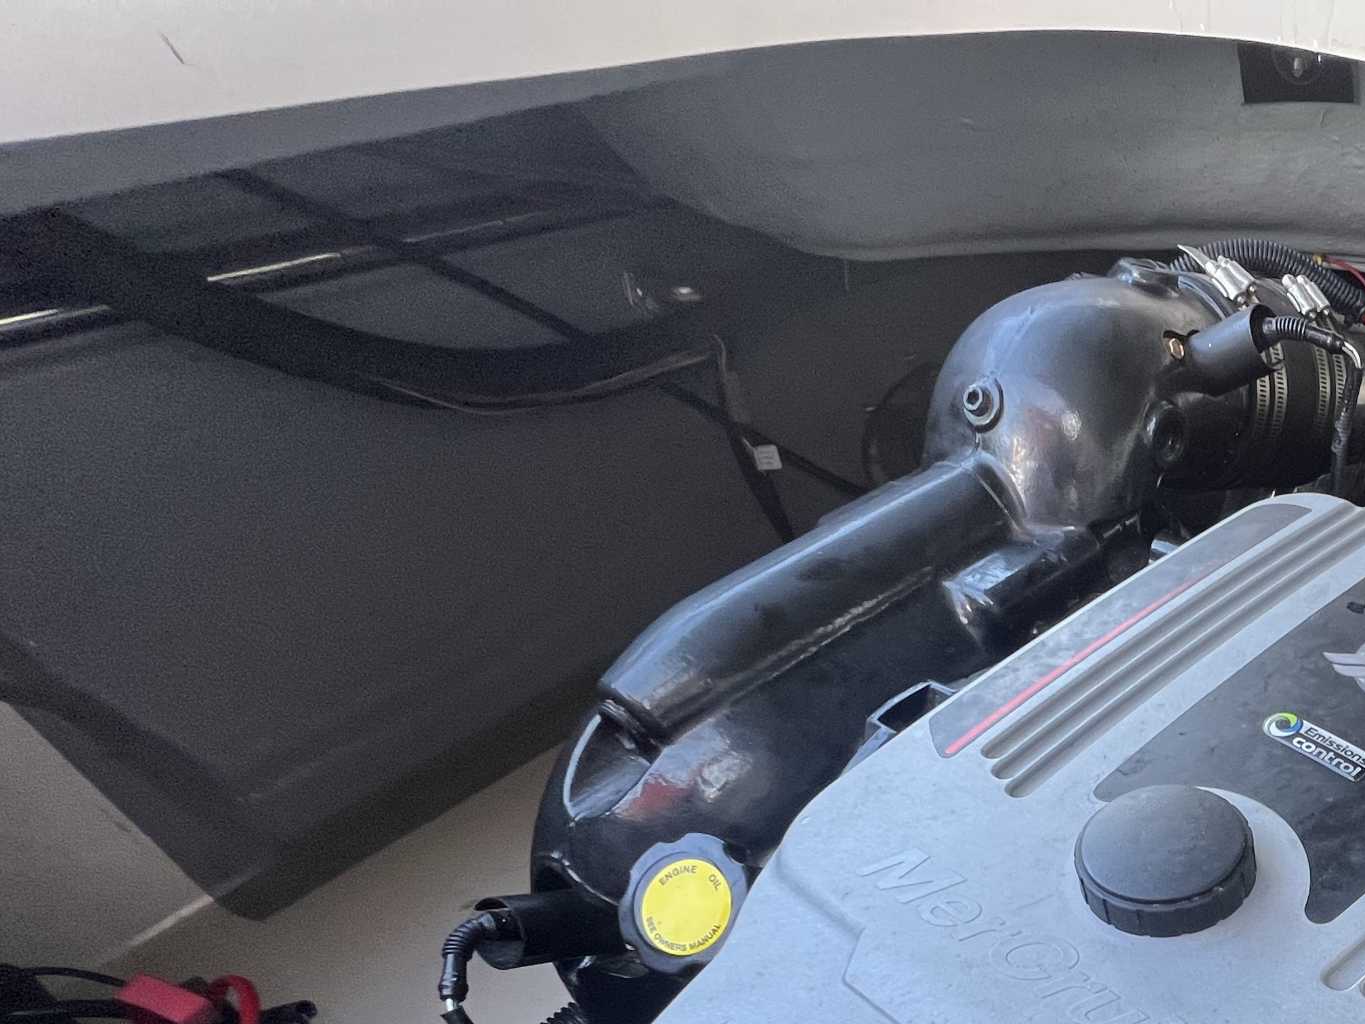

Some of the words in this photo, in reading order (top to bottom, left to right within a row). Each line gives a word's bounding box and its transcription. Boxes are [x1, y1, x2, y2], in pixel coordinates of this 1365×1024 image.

[1292, 736, 1362, 777] control
[659, 865, 697, 886] ENGINE
[708, 873, 723, 892] OIL
[688, 923, 722, 950] MANUAL
